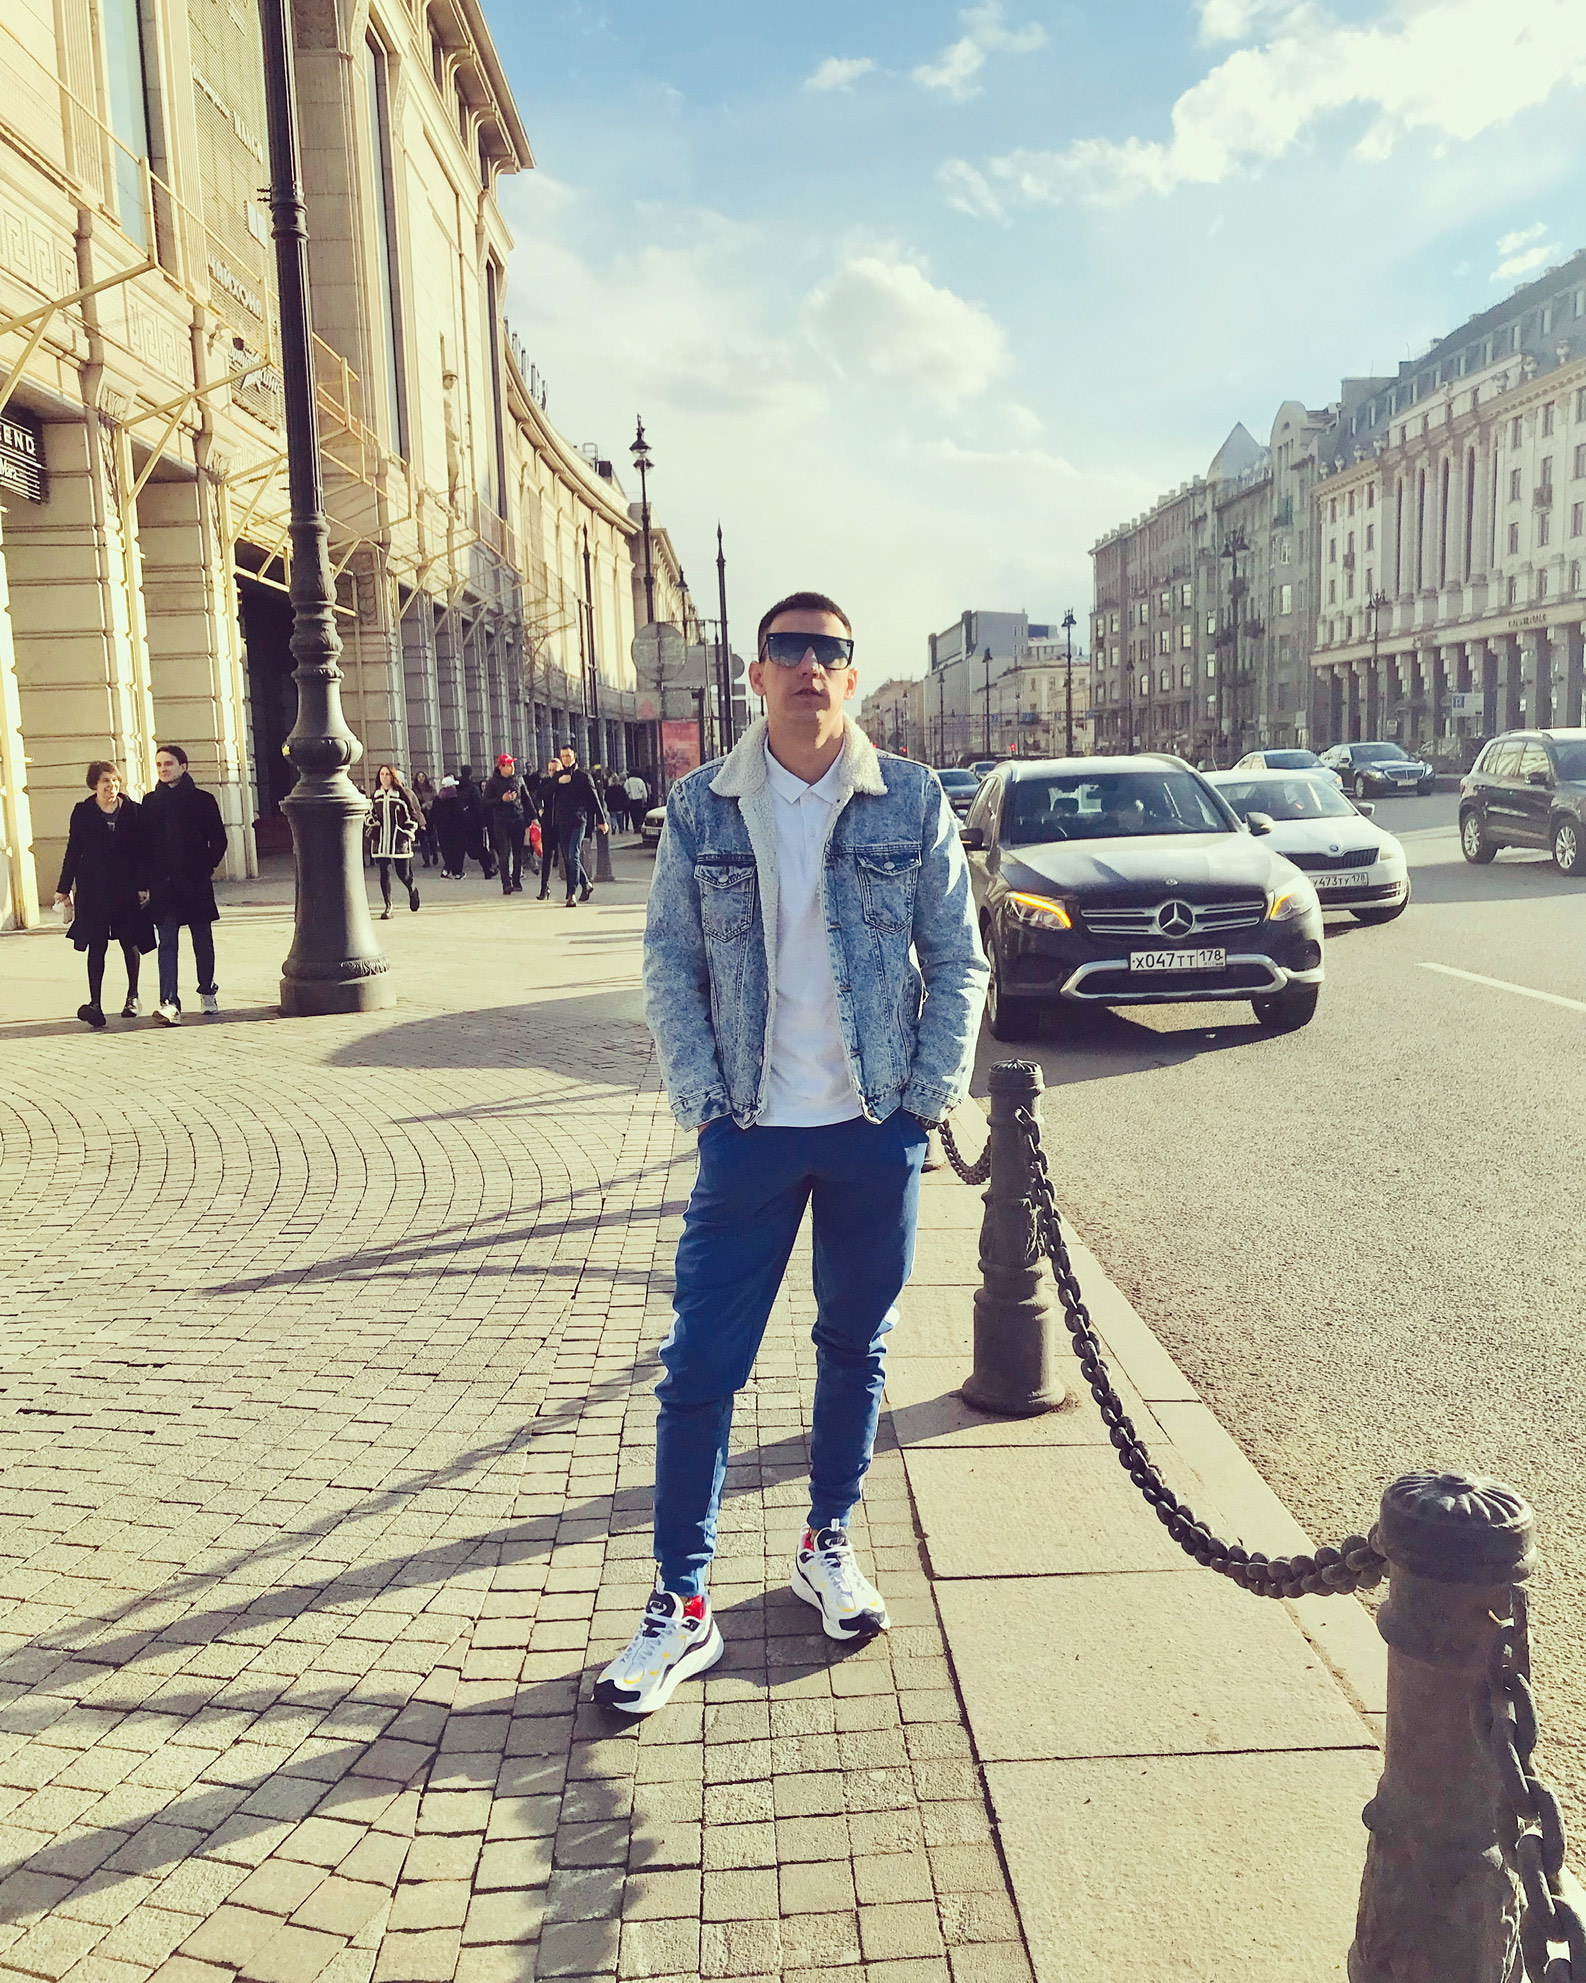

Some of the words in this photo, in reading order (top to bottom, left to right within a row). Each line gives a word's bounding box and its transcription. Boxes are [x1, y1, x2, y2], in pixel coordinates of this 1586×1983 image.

[0, 422, 36, 456] END
[1135, 952, 1195, 969] Х047ТТ
[1199, 949, 1222, 962] 178
